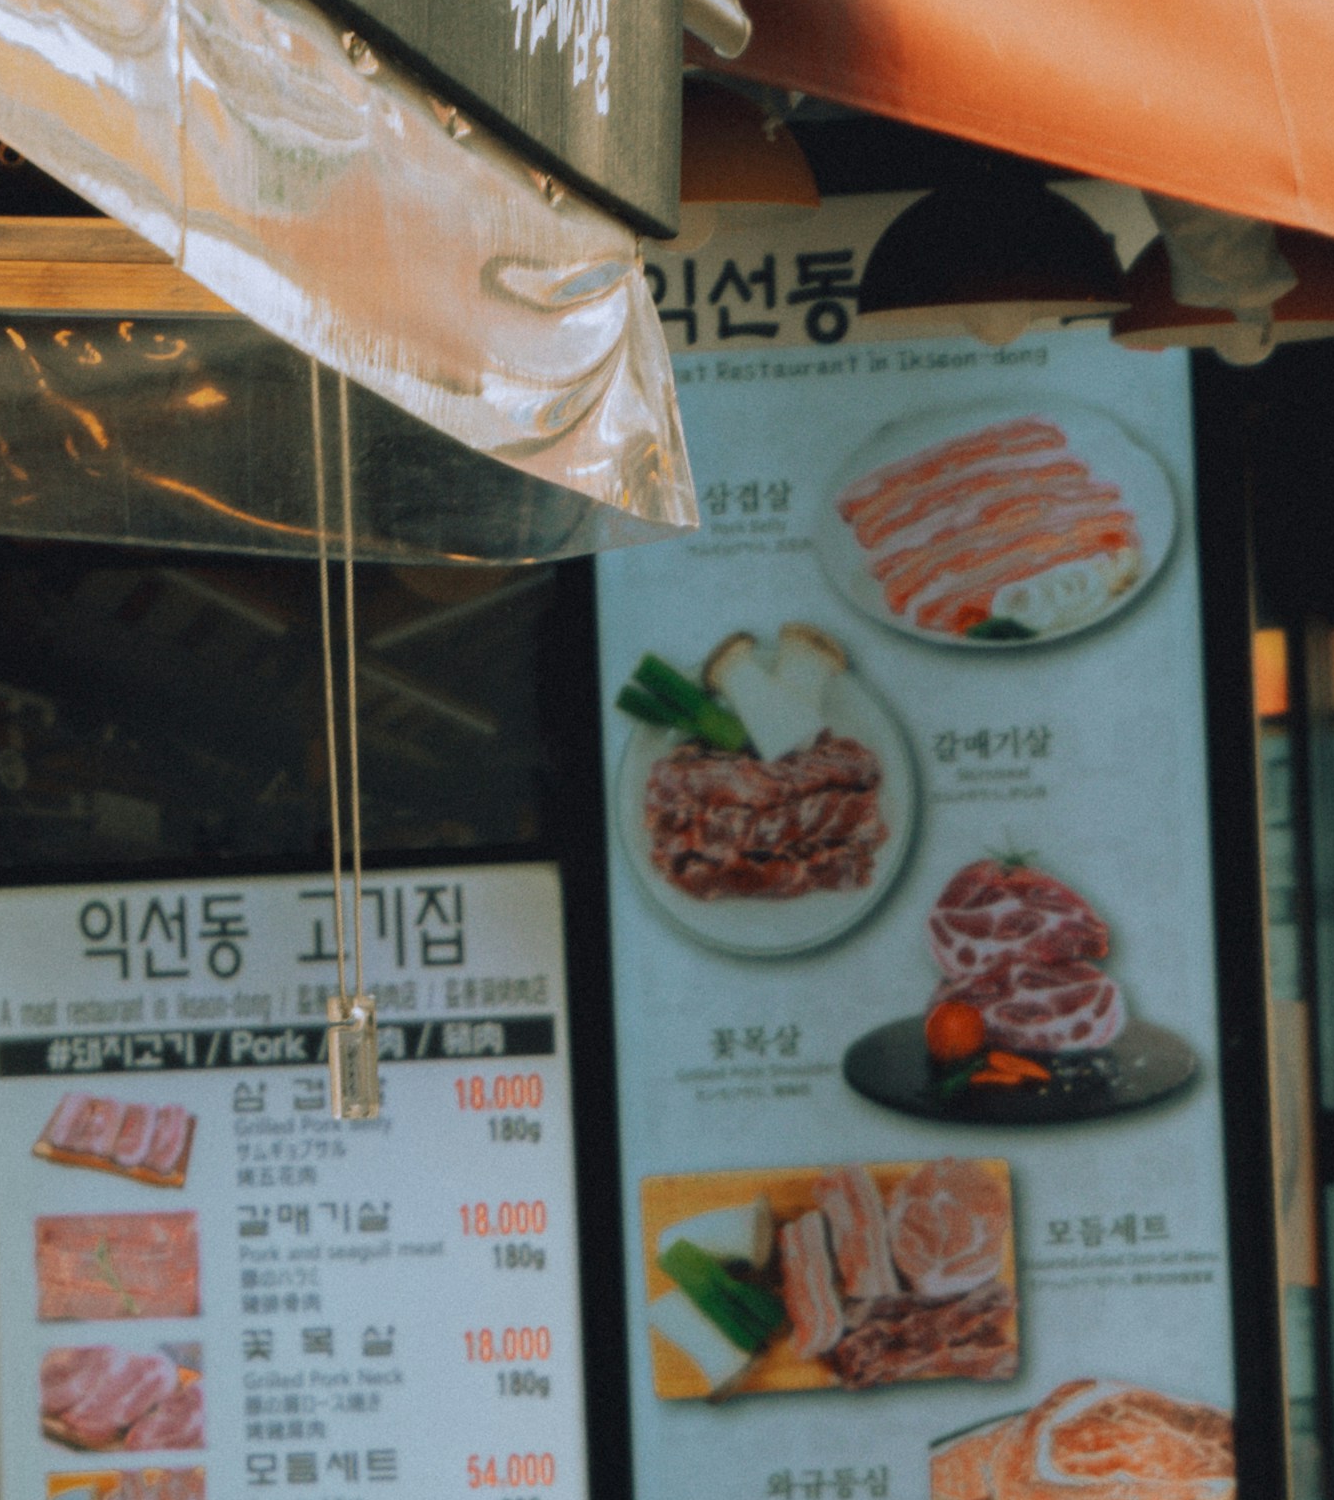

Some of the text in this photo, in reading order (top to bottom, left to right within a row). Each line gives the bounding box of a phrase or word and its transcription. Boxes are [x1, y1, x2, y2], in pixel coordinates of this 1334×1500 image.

[79, 883, 465, 980] 익선동 고기집
[230, 1027, 306, 1064] Pork
[455, 1075, 544, 1111] 18.000
[489, 1118, 543, 1146] 180g
[460, 1202, 546, 1236] 18.000
[494, 1244, 546, 1271] 180g
[463, 1327, 550, 1362] 18.000
[497, 1371, 550, 1399] 180g
[466, 1453, 555, 1488] 54.000
